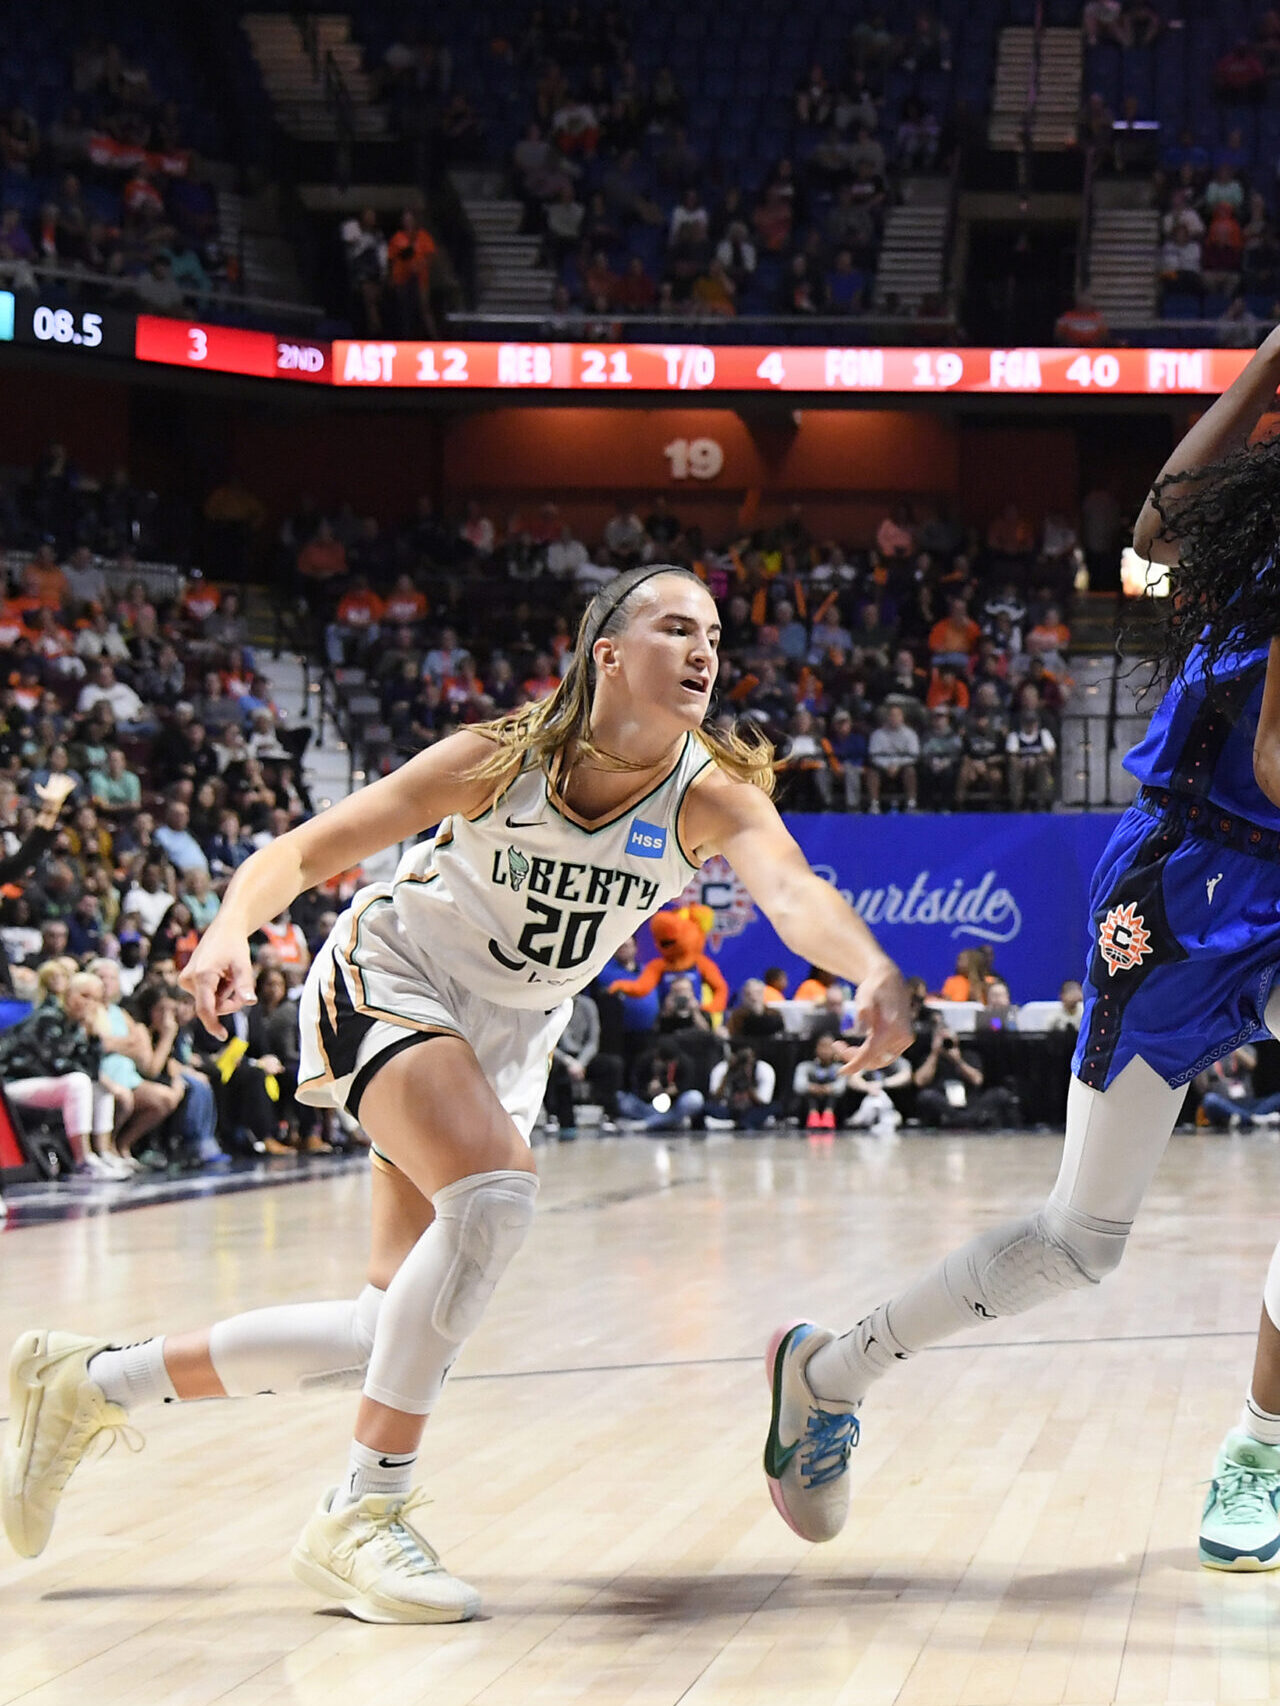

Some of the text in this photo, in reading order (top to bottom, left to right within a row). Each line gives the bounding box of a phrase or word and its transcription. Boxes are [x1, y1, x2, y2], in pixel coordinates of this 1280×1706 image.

[33, 307, 103, 347] 08.5
[187, 328, 325, 372] 3 2ND
[344, 347, 396, 381] AST
[416, 349, 468, 381] 12
[500, 347, 552, 382] REB
[580, 352, 632, 382] 21
[666, 350, 715, 387] T/O
[756, 352, 785, 384] 4
[912, 352, 963, 386] 19
[990, 352, 1041, 387] FGA
[1066, 355, 1120, 387] 40
[1148, 352, 1203, 387] FTM
[664, 438, 724, 480] 19
[631, 832, 663, 849] HSS
[518, 896, 607, 969] 20
